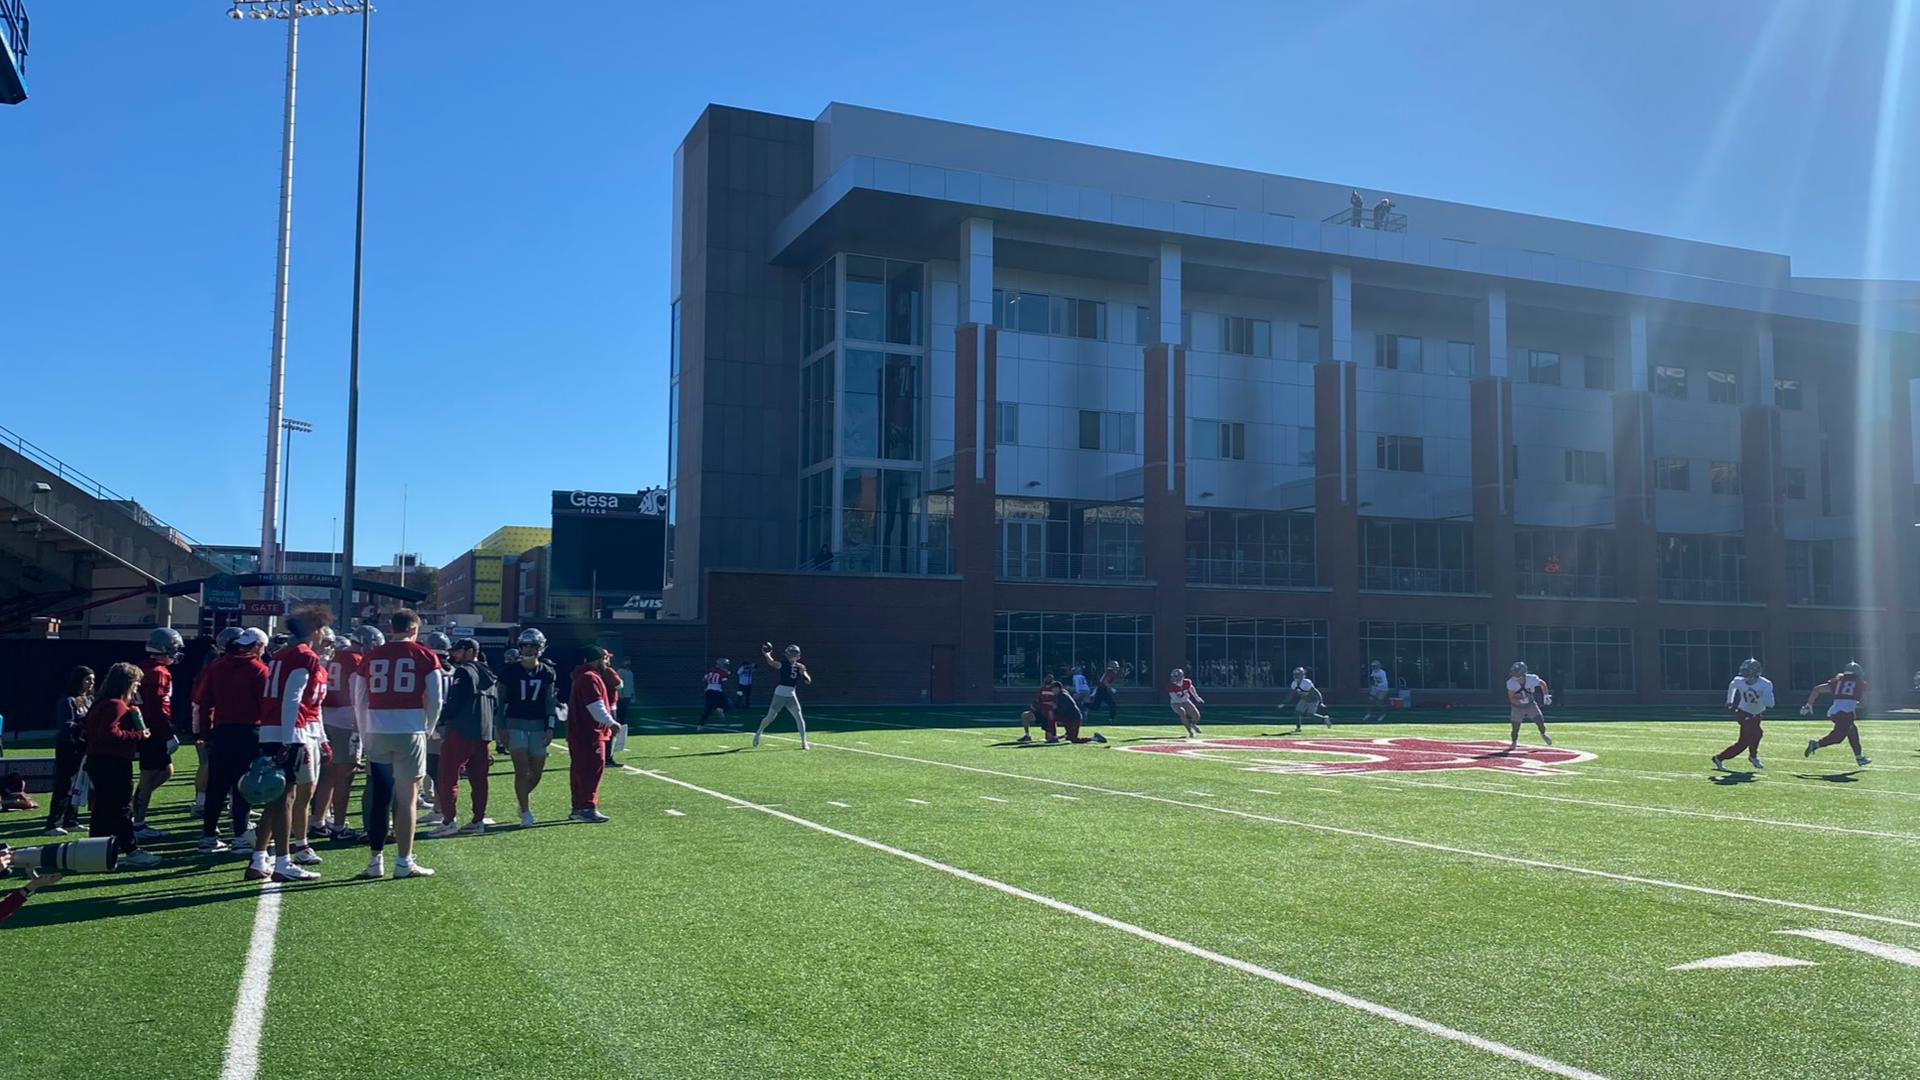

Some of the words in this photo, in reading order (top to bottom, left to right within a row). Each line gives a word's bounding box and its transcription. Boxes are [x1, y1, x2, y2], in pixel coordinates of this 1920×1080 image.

[570, 490, 619, 508] Gesa
[252, 604, 280, 612] GATE
[369, 658, 416, 693] 86
[520, 679, 542, 701] 17
[1834, 680, 1857, 696] 18
